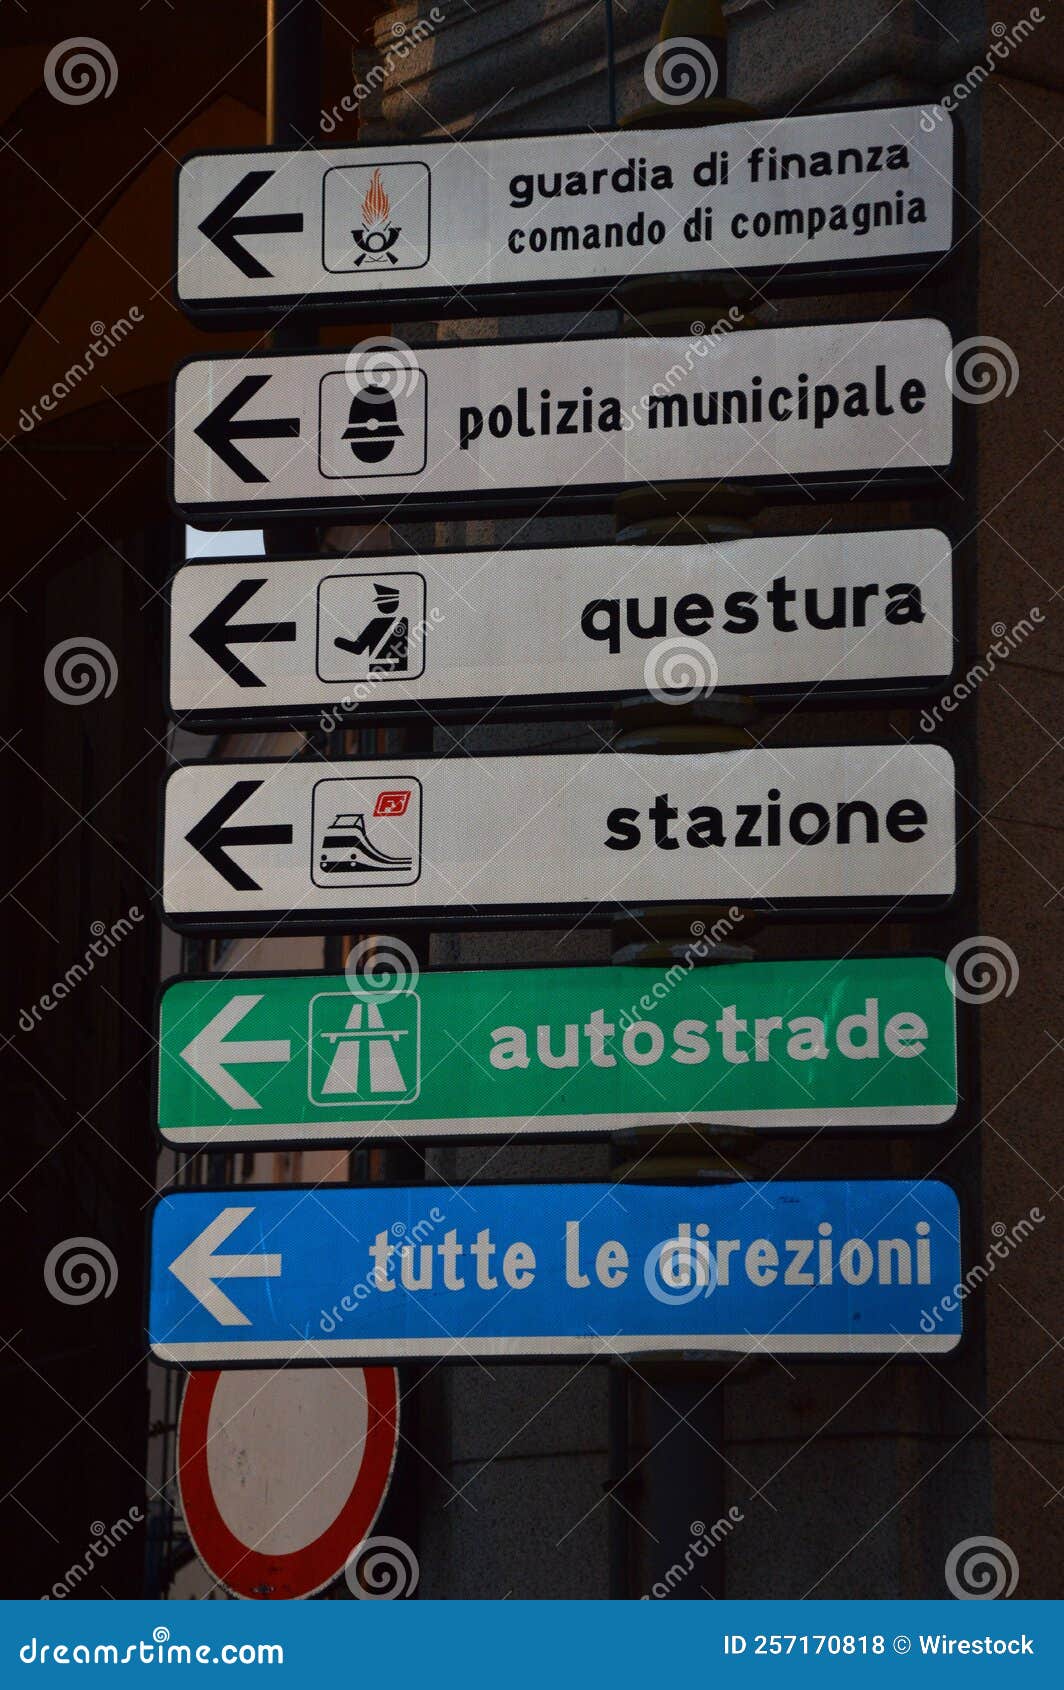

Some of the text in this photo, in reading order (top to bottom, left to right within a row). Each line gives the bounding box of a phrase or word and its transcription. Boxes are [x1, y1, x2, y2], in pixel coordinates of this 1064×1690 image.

[508, 143, 911, 209] guardia di finanza
[507, 189, 928, 255] comando di compagnia
[459, 364, 927, 451] polizia municipale
[580, 579, 926, 655] questura
[603, 788, 928, 851] stazione
[488, 997, 929, 1071] autostrade
[367, 1220, 931, 1293] tutte le direzioni
